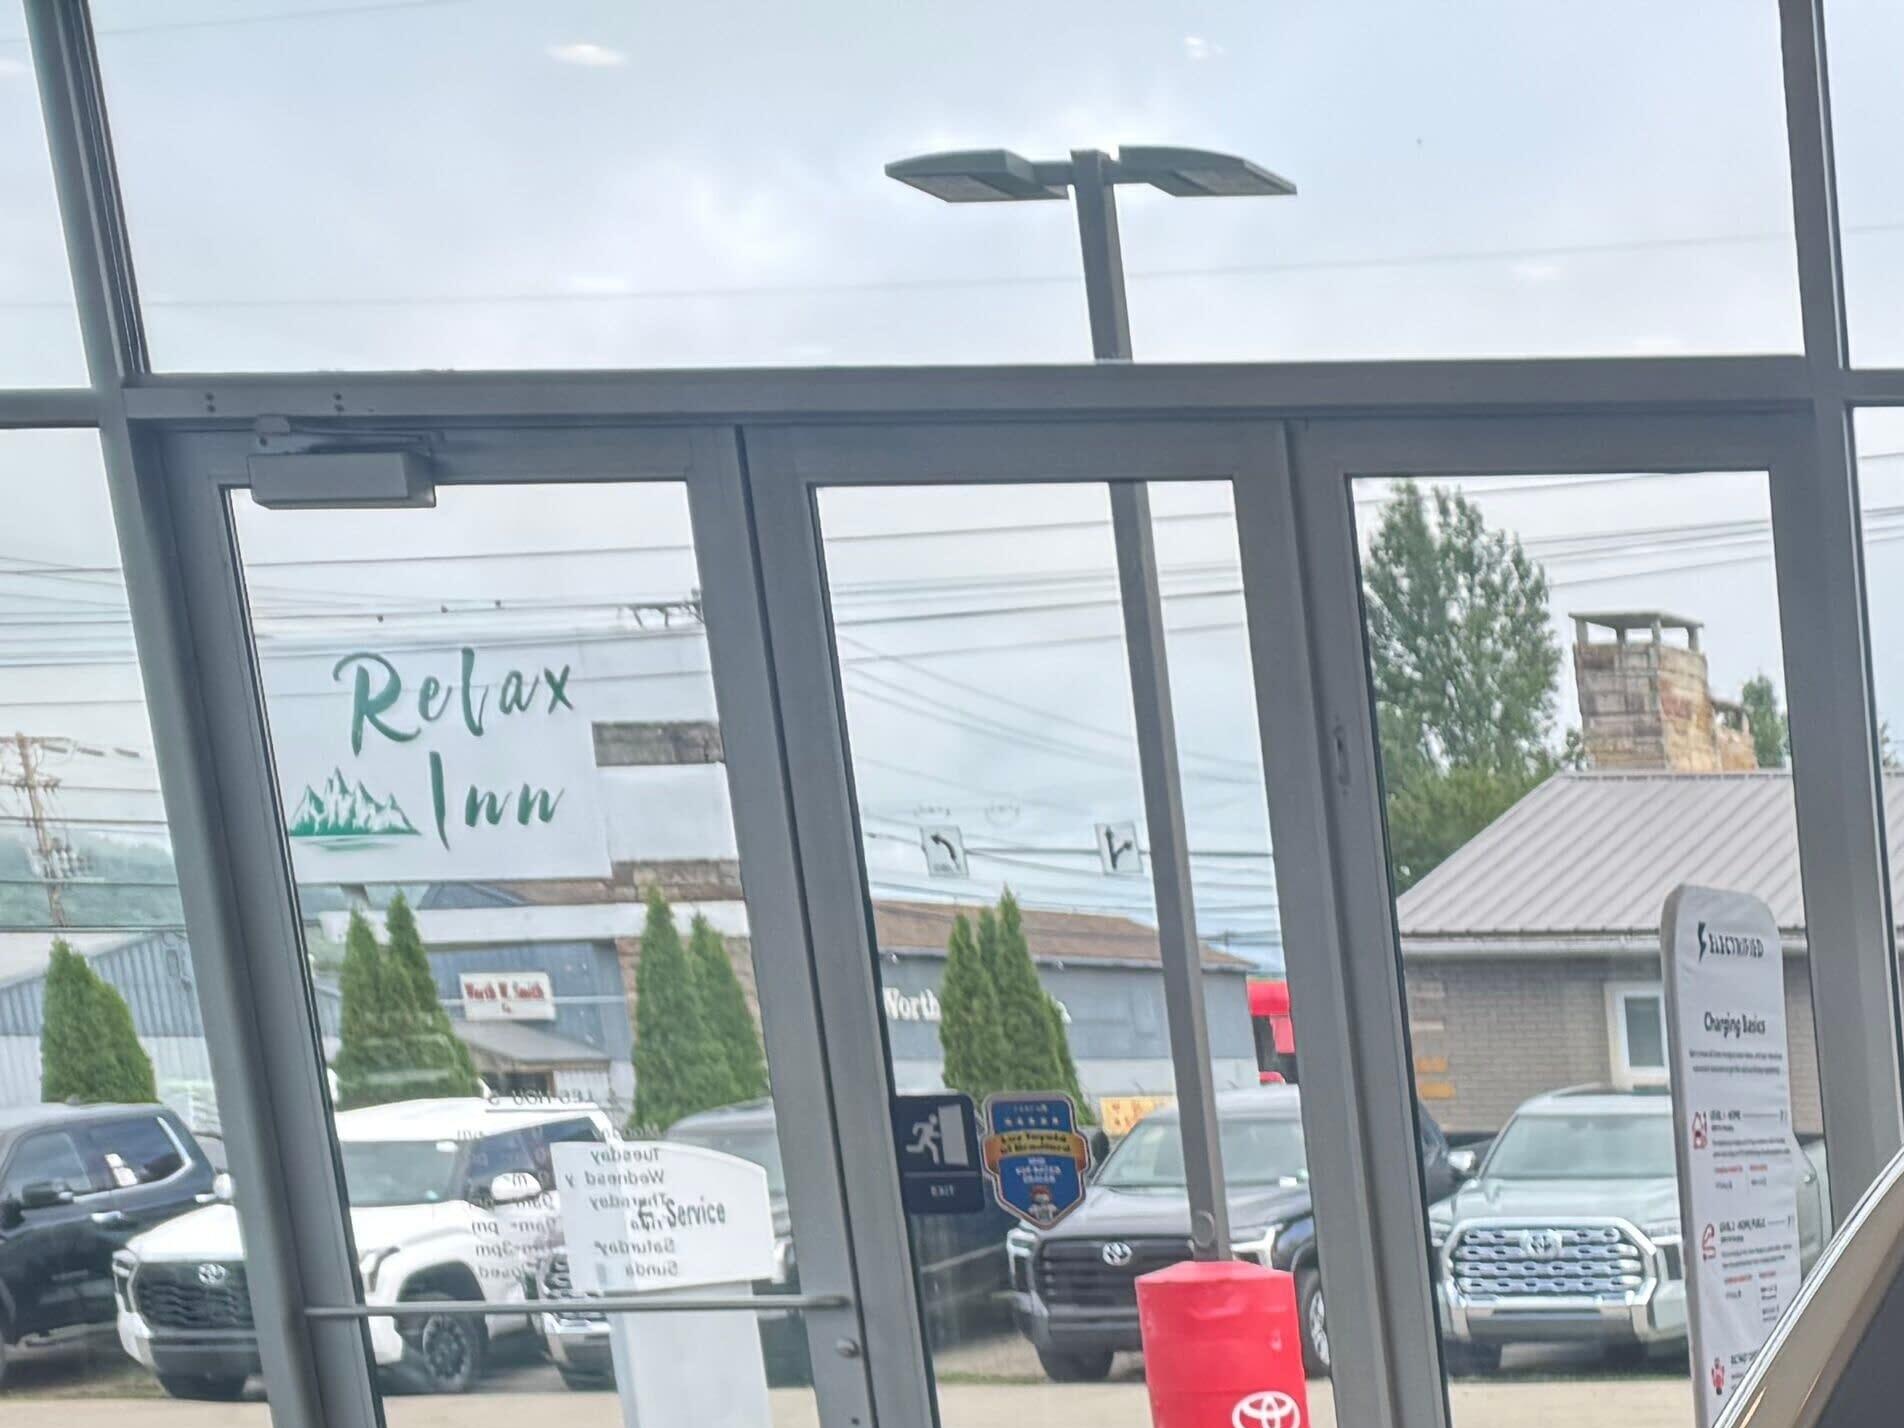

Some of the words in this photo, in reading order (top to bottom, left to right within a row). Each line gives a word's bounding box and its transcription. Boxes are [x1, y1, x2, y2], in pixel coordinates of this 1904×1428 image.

[333, 647, 574, 757] Relax
[429, 751, 564, 851] Inn
[1709, 933, 1764, 959] ELECTRIFIED
[1704, 1010, 1741, 1039] Charging
[1742, 1013, 1766, 1035] Basics
[930, 1184, 955, 1198] EXIT
[666, 1194, 726, 1229] Service
